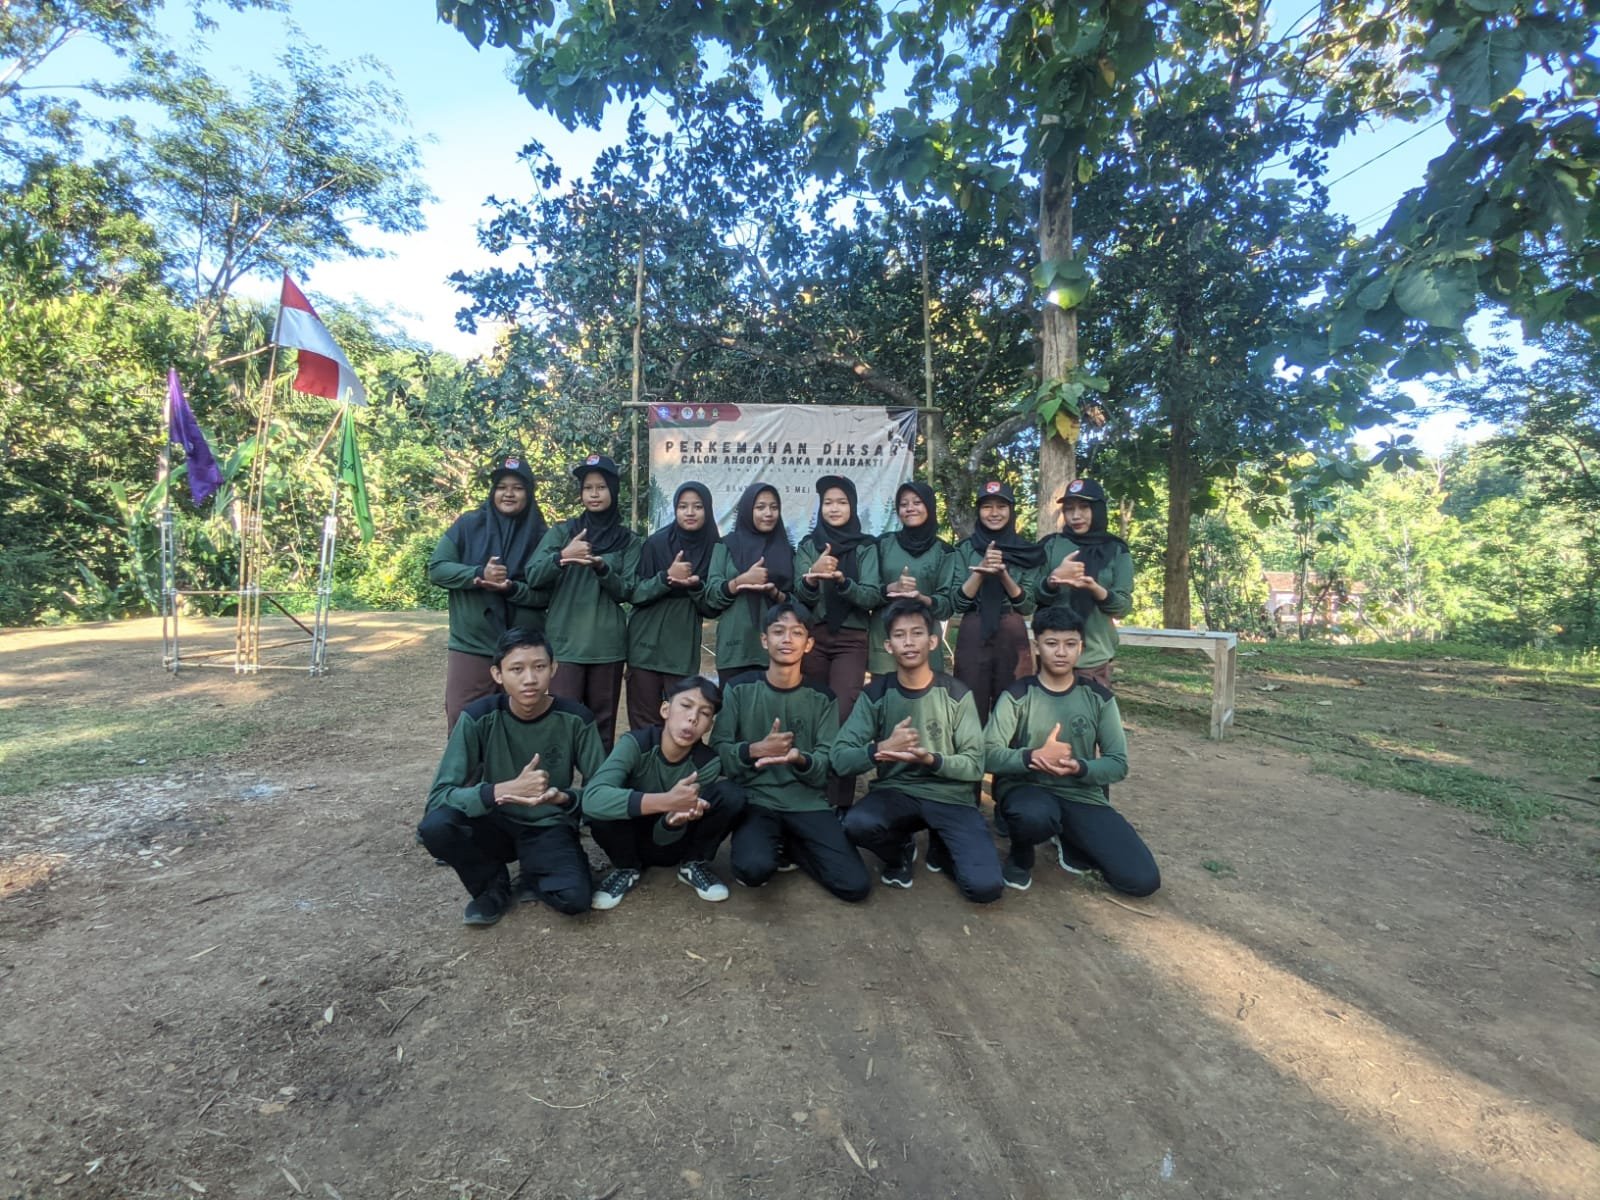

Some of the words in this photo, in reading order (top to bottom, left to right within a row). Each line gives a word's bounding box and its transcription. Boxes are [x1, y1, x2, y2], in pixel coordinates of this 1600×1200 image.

[665, 441, 807, 455] PERKEMAHAN
[681, 455, 718, 464] CALON
[723, 456, 775, 465] ANGGOTA
[781, 456, 811, 466] SAKA
[817, 457, 884, 467] WANABAKTI
